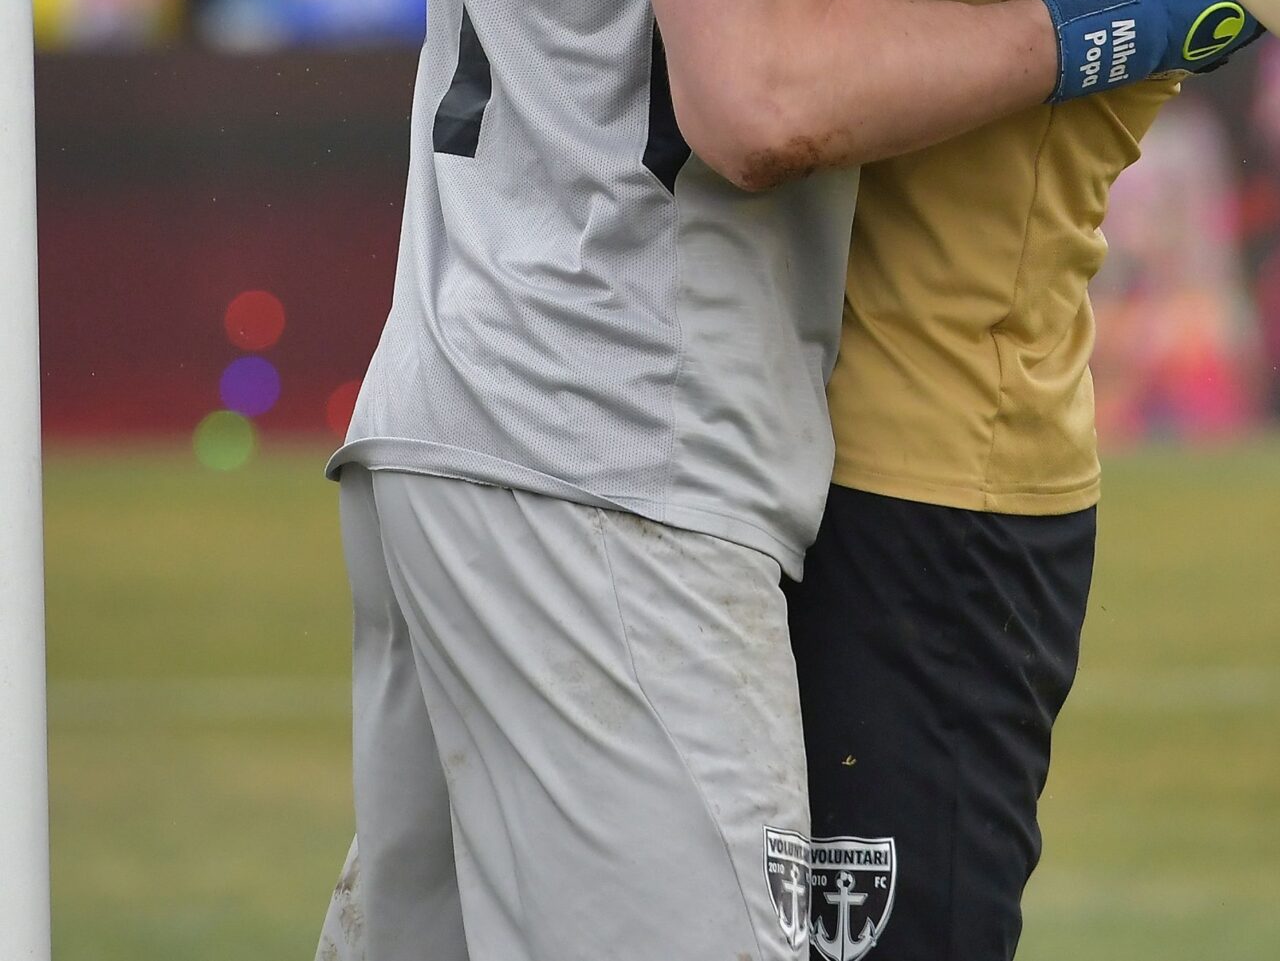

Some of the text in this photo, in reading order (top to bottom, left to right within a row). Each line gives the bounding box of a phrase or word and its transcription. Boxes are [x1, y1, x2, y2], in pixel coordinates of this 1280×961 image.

[1080, 29, 1107, 88] Popa
[1108, 19, 1137, 84] Mihai
[811, 848, 889, 865] VOLUNTARI
[768, 861, 785, 875] 2010
[811, 874, 828, 888] 010
[874, 876, 888, 889] FC
